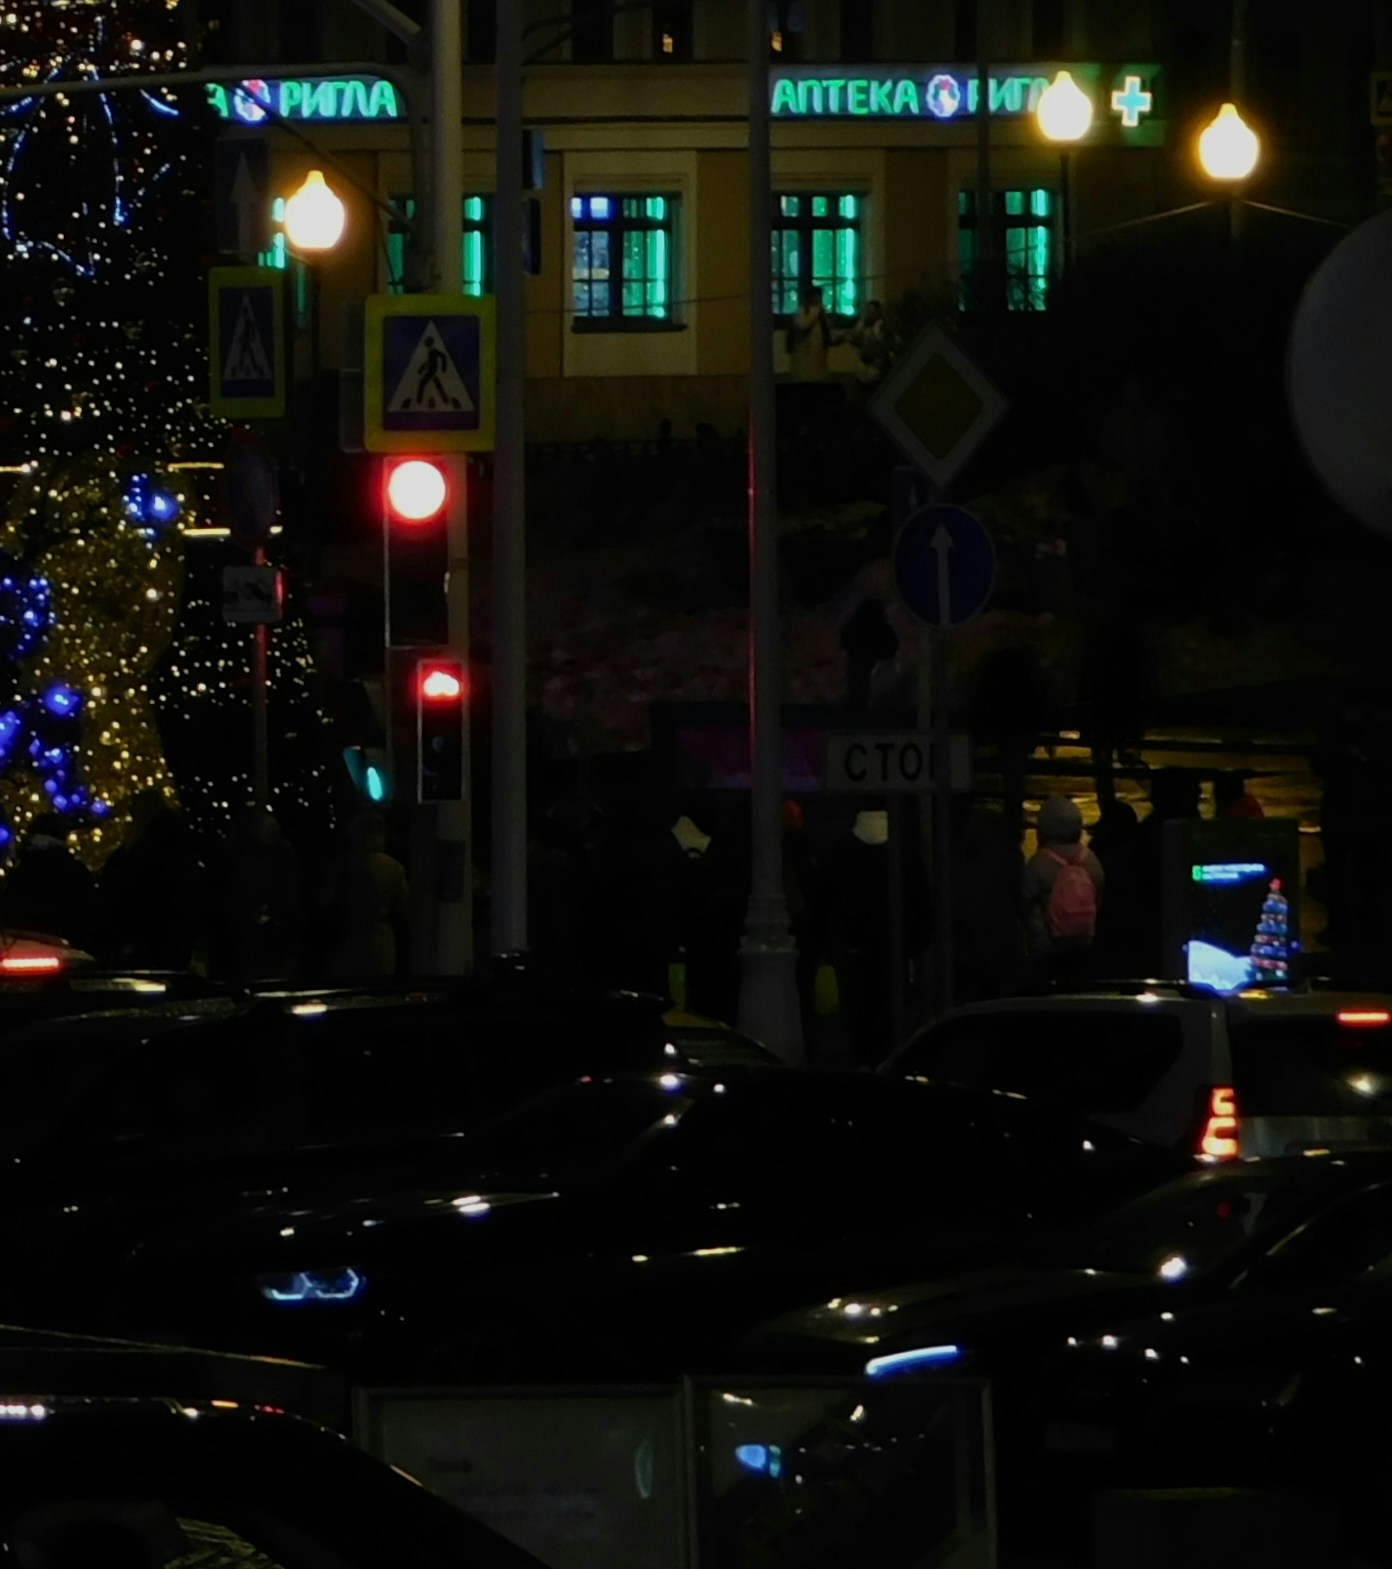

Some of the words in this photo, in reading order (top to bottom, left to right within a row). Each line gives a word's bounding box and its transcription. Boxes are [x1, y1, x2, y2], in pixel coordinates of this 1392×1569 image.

[278, 79, 398, 118] РИГЛА
[771, 79, 919, 115] АПТЕКА
[844, 742, 936, 782] СТО
